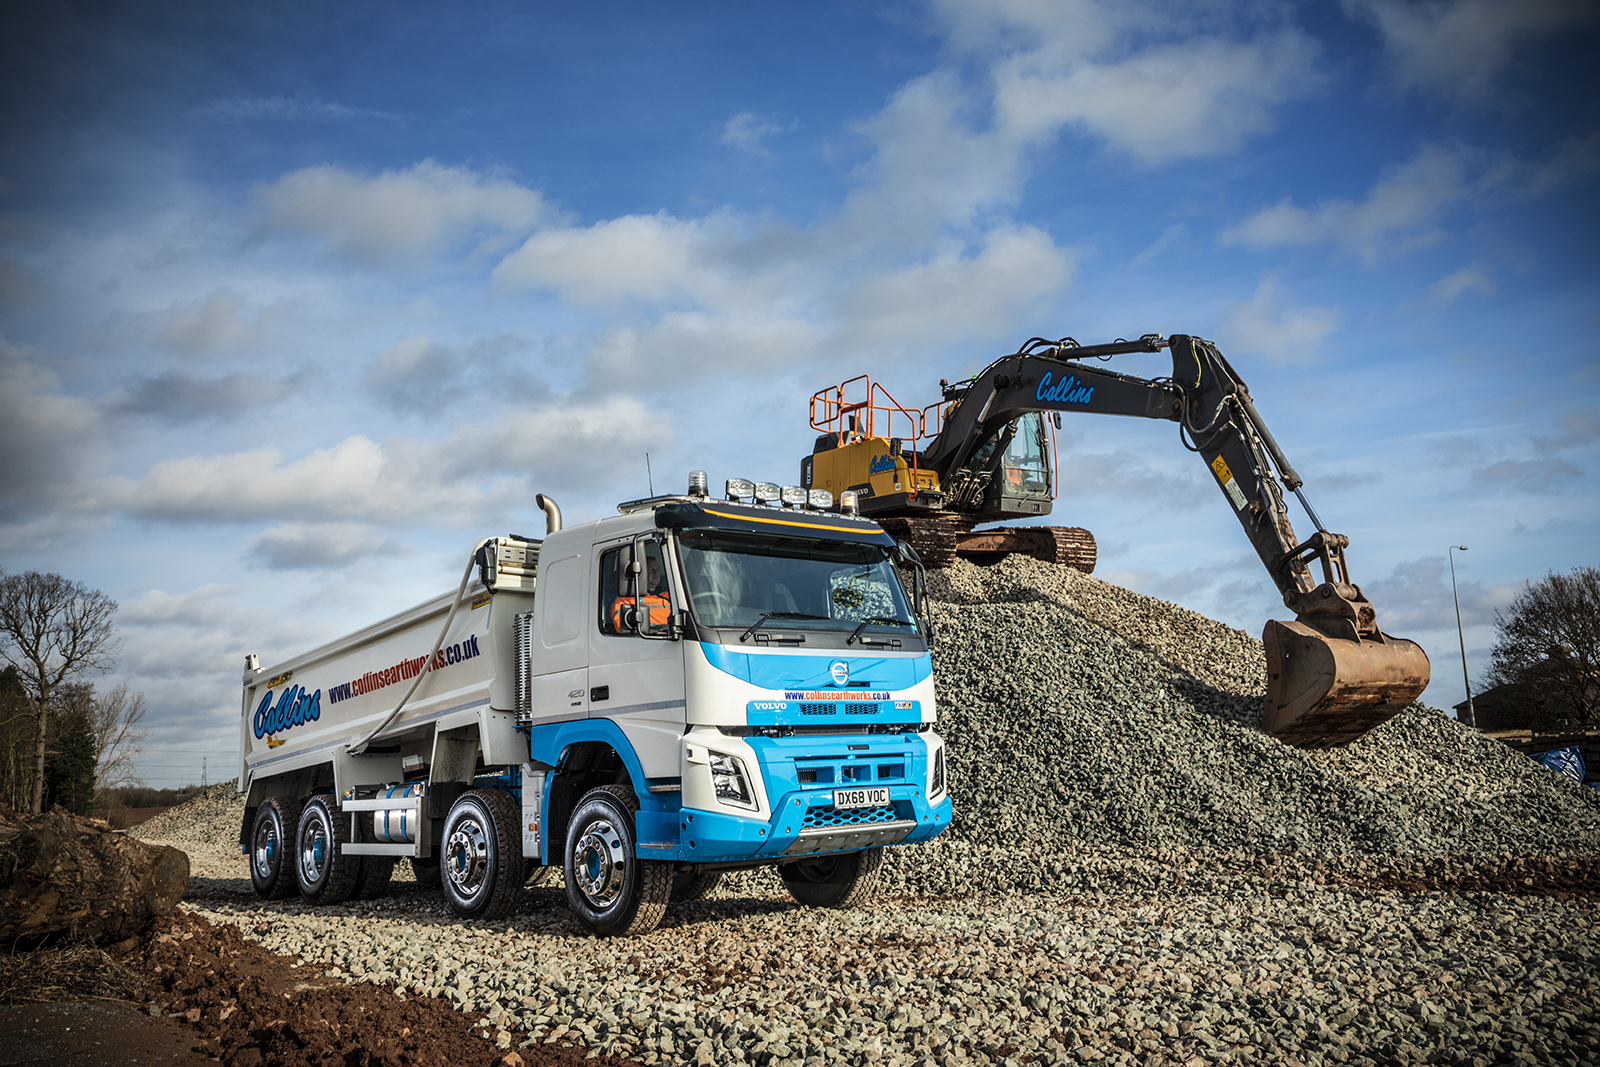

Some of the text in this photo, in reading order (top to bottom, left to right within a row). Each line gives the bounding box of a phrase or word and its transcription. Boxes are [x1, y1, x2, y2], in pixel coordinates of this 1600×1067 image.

[1035, 370, 1095, 405] Collins
[568, 688, 585, 698] 420
[785, 691, 891, 700] www.collinsearthworks.co.uk
[253, 683, 321, 740] Collins
[838, 790, 885, 804] DX68 VOC
